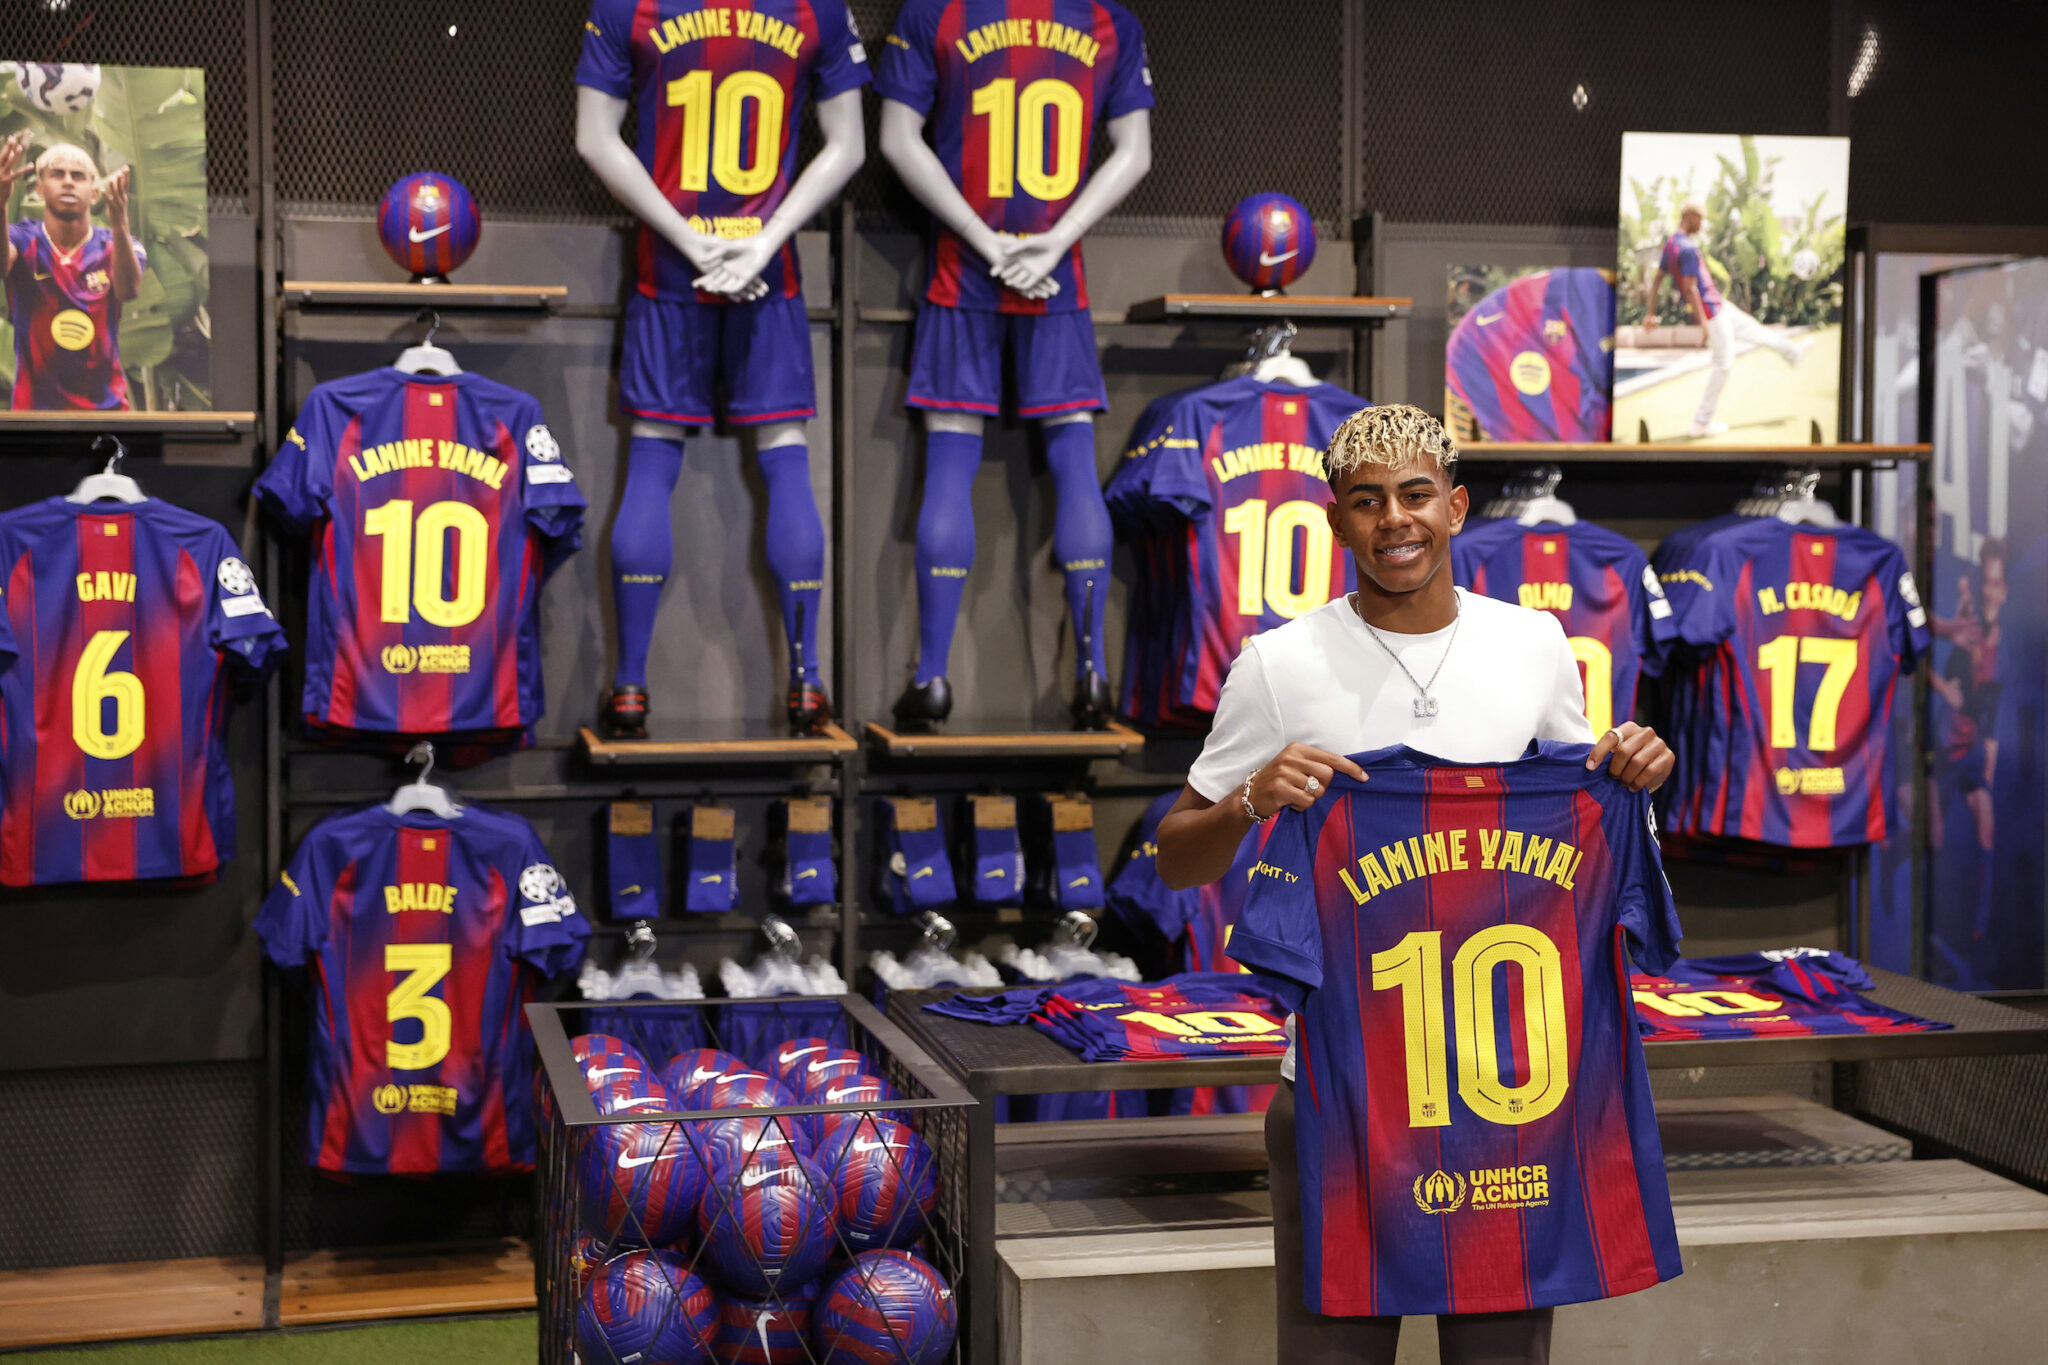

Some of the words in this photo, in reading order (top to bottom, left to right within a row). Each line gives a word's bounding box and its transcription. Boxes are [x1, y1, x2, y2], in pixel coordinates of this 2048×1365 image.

[648, 7, 732, 54] LAMINE
[736, 8, 805, 59] YAMAL
[955, 18, 1033, 63] LAMINE
[1036, 19, 1100, 67] YAMAL
[666, 69, 785, 195] 10
[972, 78, 1083, 201] 10
[348, 438, 434, 482] LAMINE
[437, 440, 509, 490] YAMAL
[1211, 441, 1286, 483] LAMINE
[1287, 442, 1329, 483] YAM
[363, 499, 490, 628] 10
[1223, 498, 1333, 620] 10
[76, 571, 137, 603] GAVI
[1518, 581, 1574, 611] OLMO
[72, 630, 146, 760] 6
[1757, 635, 1859, 752] 17
[1337, 828, 1469, 906] LAMINE
[1478, 828, 1584, 891] YAMAL
[384, 883, 458, 914] BALDE
[384, 944, 453, 1070] 3
[1371, 923, 1570, 1128] 10
[1469, 1164, 1548, 1186] UNHCR
[1471, 1181, 1549, 1204] ACNUR
[1497, 1201, 1524, 1209] Refugee
[1525, 1200, 1550, 1208] Agency
